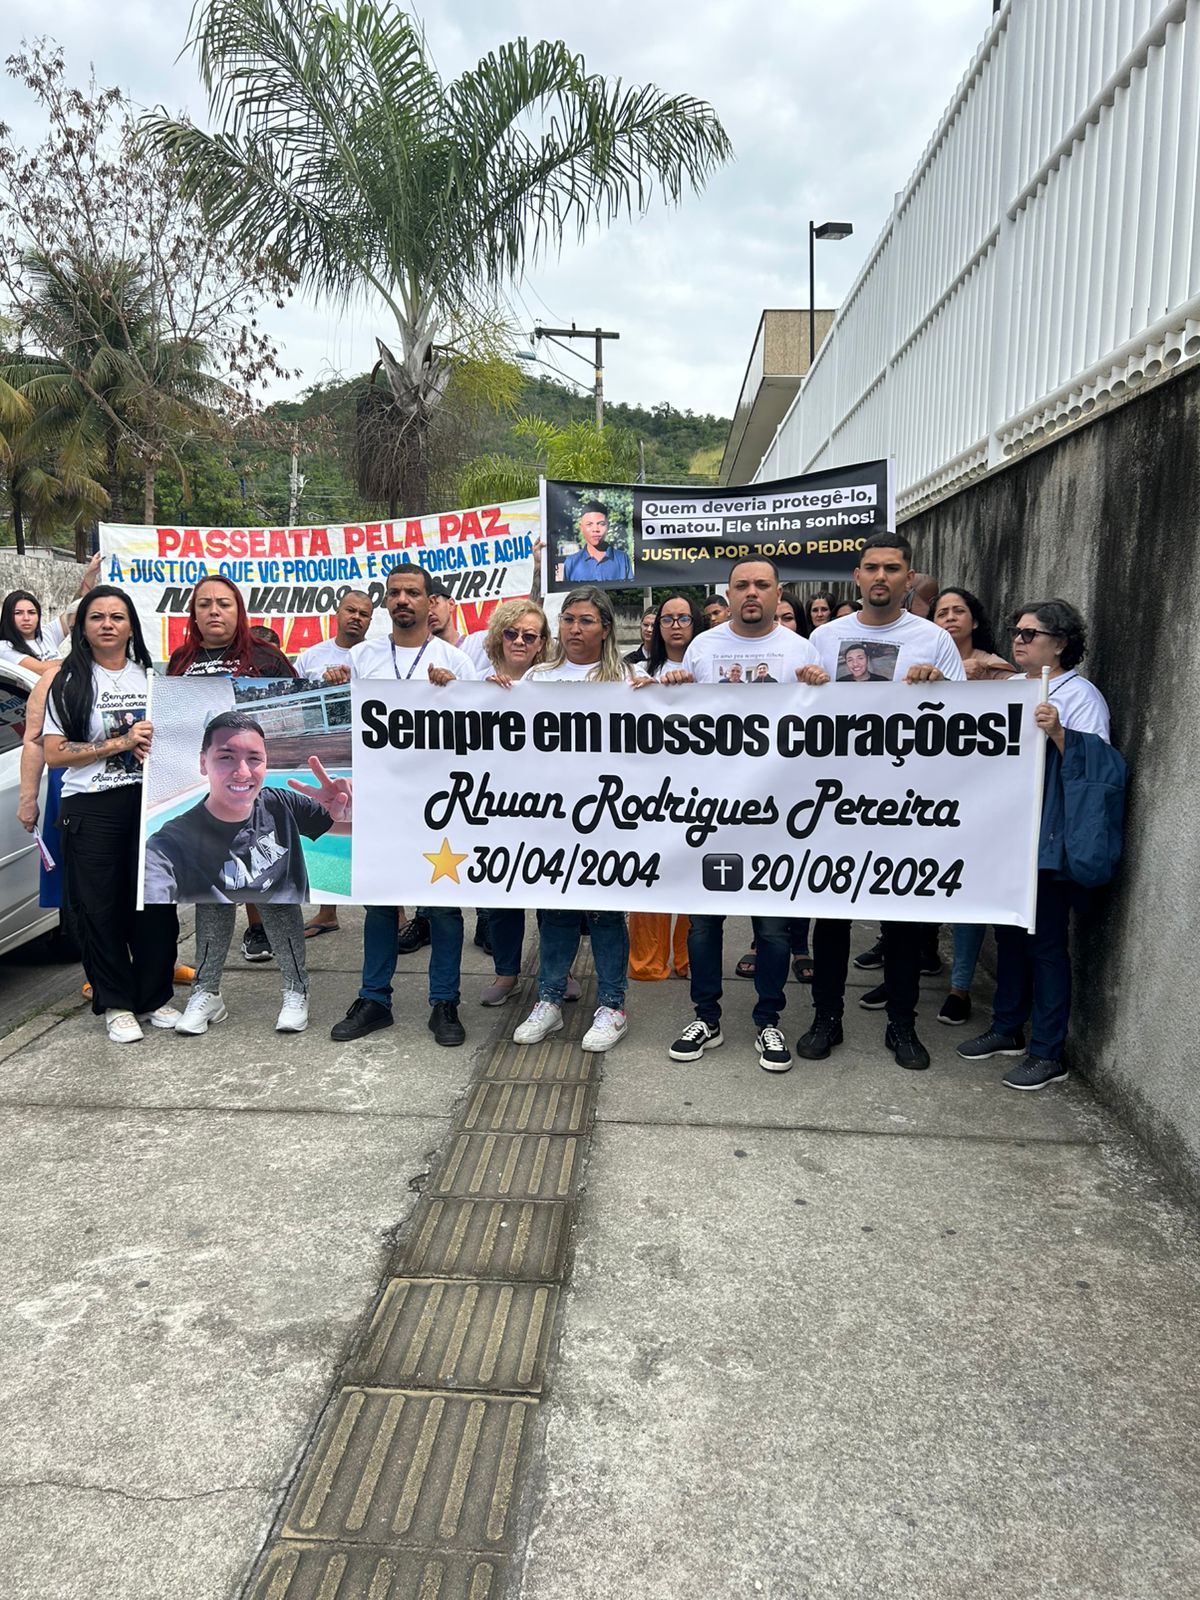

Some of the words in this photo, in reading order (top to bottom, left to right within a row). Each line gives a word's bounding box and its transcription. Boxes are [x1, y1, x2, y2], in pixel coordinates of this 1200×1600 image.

[645, 501, 697, 517] Quem
[702, 497, 766, 514] deveria
[772, 489, 873, 515] protegê-lo,
[645, 523, 656, 536] o
[660, 519, 720, 536] matou.
[726, 517, 752, 533] Ele
[756, 514, 800, 531] tinha
[805, 510, 875, 529] sonhos!
[156, 528, 331, 558] PASSEATA
[344, 520, 424, 554] PELA
[439, 508, 510, 544] PAZ
[641, 547, 710, 563] JUSTIÇA
[714, 545, 749, 558] POR
[754, 540, 801, 557] JOÃO
[806, 538, 868, 554] PEDRO
[218, 560, 254, 583] QUE
[257, 560, 279, 583] VC
[283, 556, 362, 583] PROCURA
[367, 552, 378, 578] É
[470, 542, 491, 567] DE
[101, 691, 137, 702] Sempre
[361, 700, 525, 755] Sempre
[533, 711, 602, 752] em
[609, 713, 769, 756] nossos
[777, 701, 1022, 768] corações!
[425, 771, 566, 830] Rhuan
[571, 774, 780, 847] Rodrigues
[786, 778, 961, 839] Pereira
[467, 841, 661, 893] 30/04/2004
[747, 848, 965, 903] 20/08/2024
